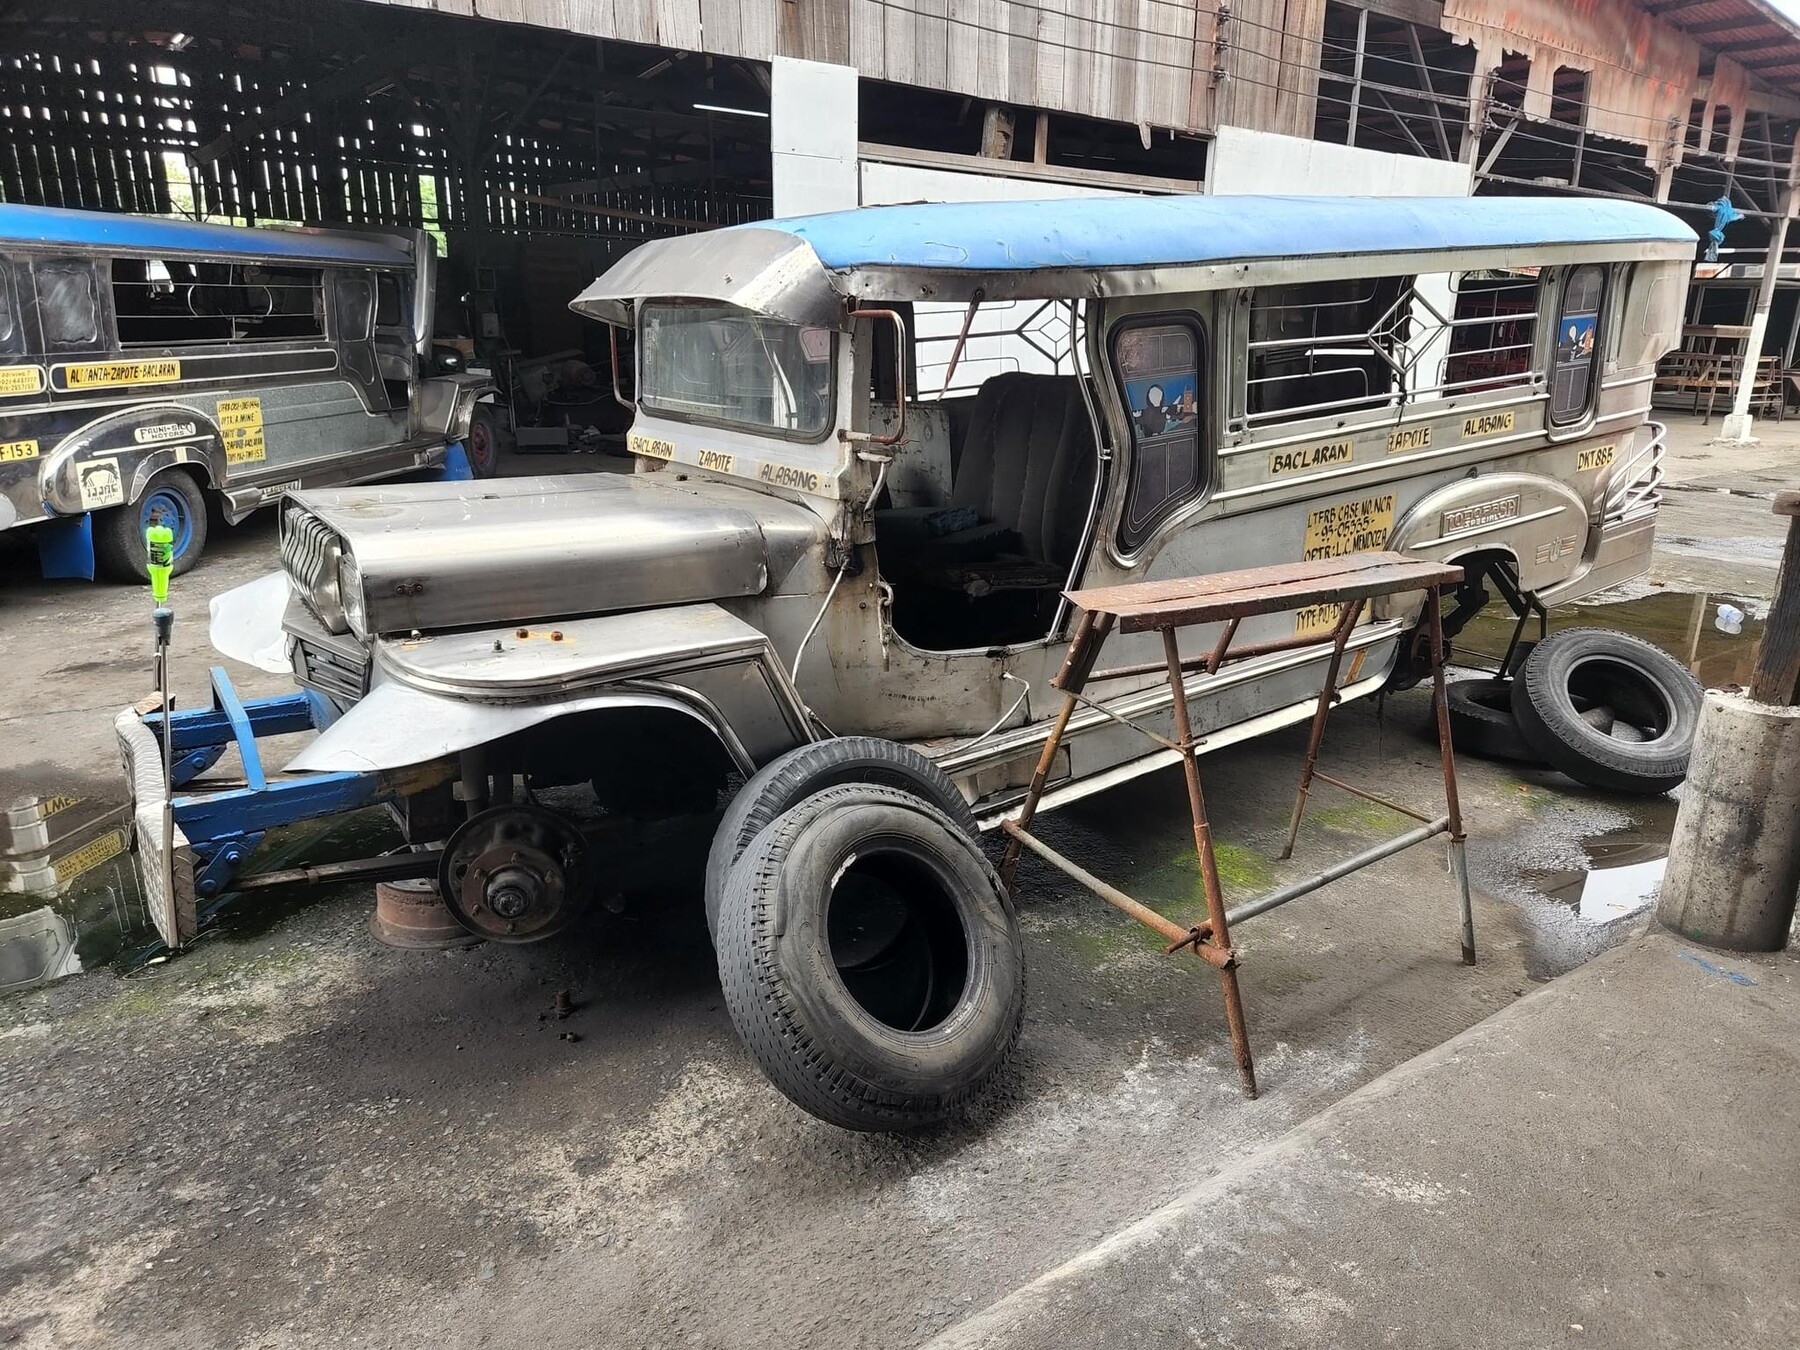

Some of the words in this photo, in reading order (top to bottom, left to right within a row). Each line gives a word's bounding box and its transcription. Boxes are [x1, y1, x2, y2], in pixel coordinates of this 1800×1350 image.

[151, 430, 185, 439] MOTORS
[1463, 414, 1512, 437] ALABANG
[632, 437, 673, 457] BACLARAN
[1388, 428, 1430, 452] ZAPOTE
[699, 449, 732, 472] ZAPOTE
[1271, 443, 1348, 473] BACLARAN
[760, 464, 818, 492] ALABANG
[1307, 507, 1336, 528] LTFRB
[1337, 502, 1359, 522] CASE
